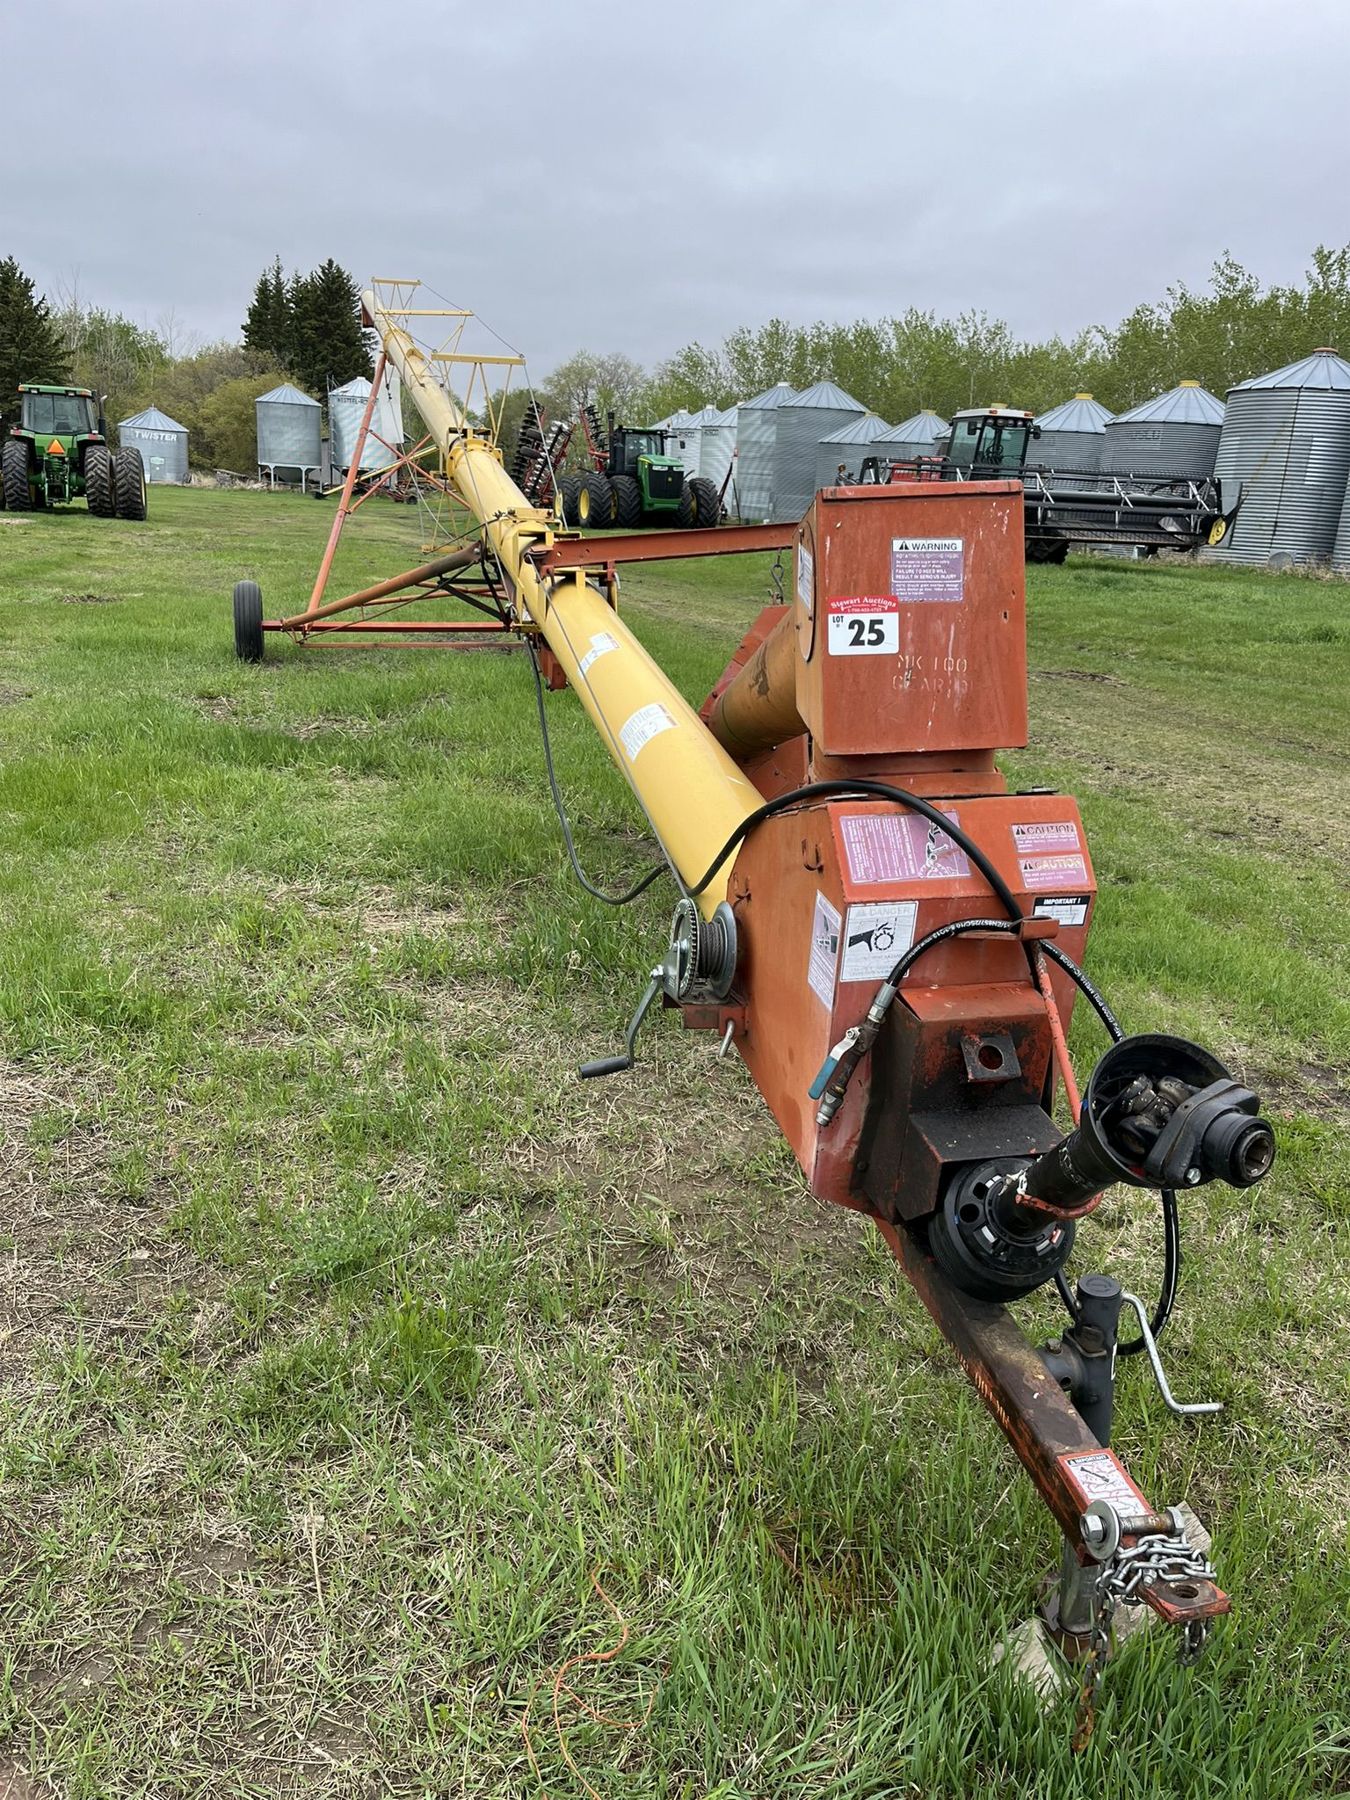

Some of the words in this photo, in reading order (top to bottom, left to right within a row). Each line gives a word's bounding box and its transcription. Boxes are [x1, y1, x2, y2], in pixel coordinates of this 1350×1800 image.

[135, 430, 178, 441] TWISTER
[911, 542, 957, 551] WARNING
[830, 597, 861, 609] Stewart
[862, 596, 897, 607] Auctions
[832, 615, 844, 623] LOT
[848, 619, 885, 647] 25
[1026, 824, 1075, 835] CAUTION
[1034, 858, 1081, 870] CAUTION
[870, 906, 911, 916] DANGER
